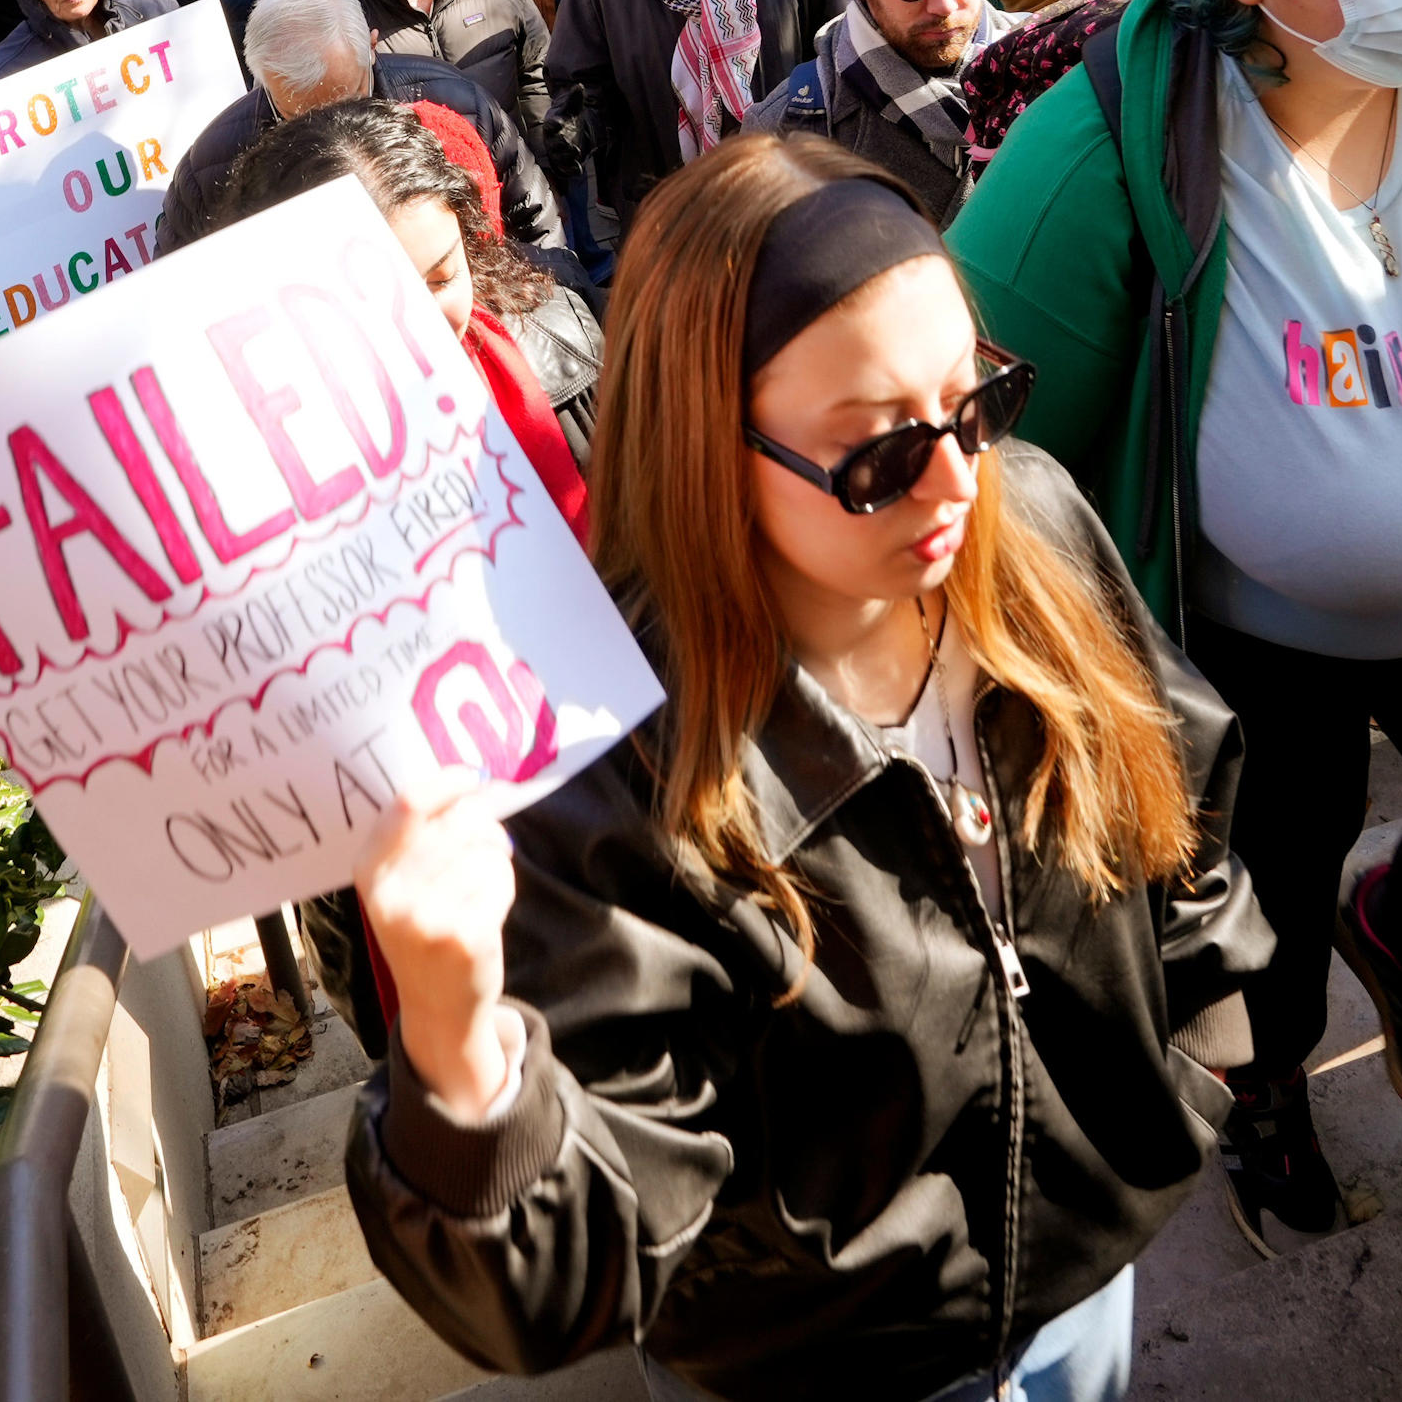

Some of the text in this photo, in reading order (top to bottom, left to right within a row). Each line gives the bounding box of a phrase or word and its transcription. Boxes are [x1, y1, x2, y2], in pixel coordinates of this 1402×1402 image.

[62, 137, 170, 214] OUR
[4, 682, 104, 772] GET
[90, 642, 222, 736] YOUR
[201, 532, 403, 684] PROFESSOR
[190, 735, 250, 787] FOR
[248, 713, 280, 759] A
[275, 663, 383, 748] LIMITED
[165, 782, 322, 884] ONLY
[333, 723, 399, 832] AT
